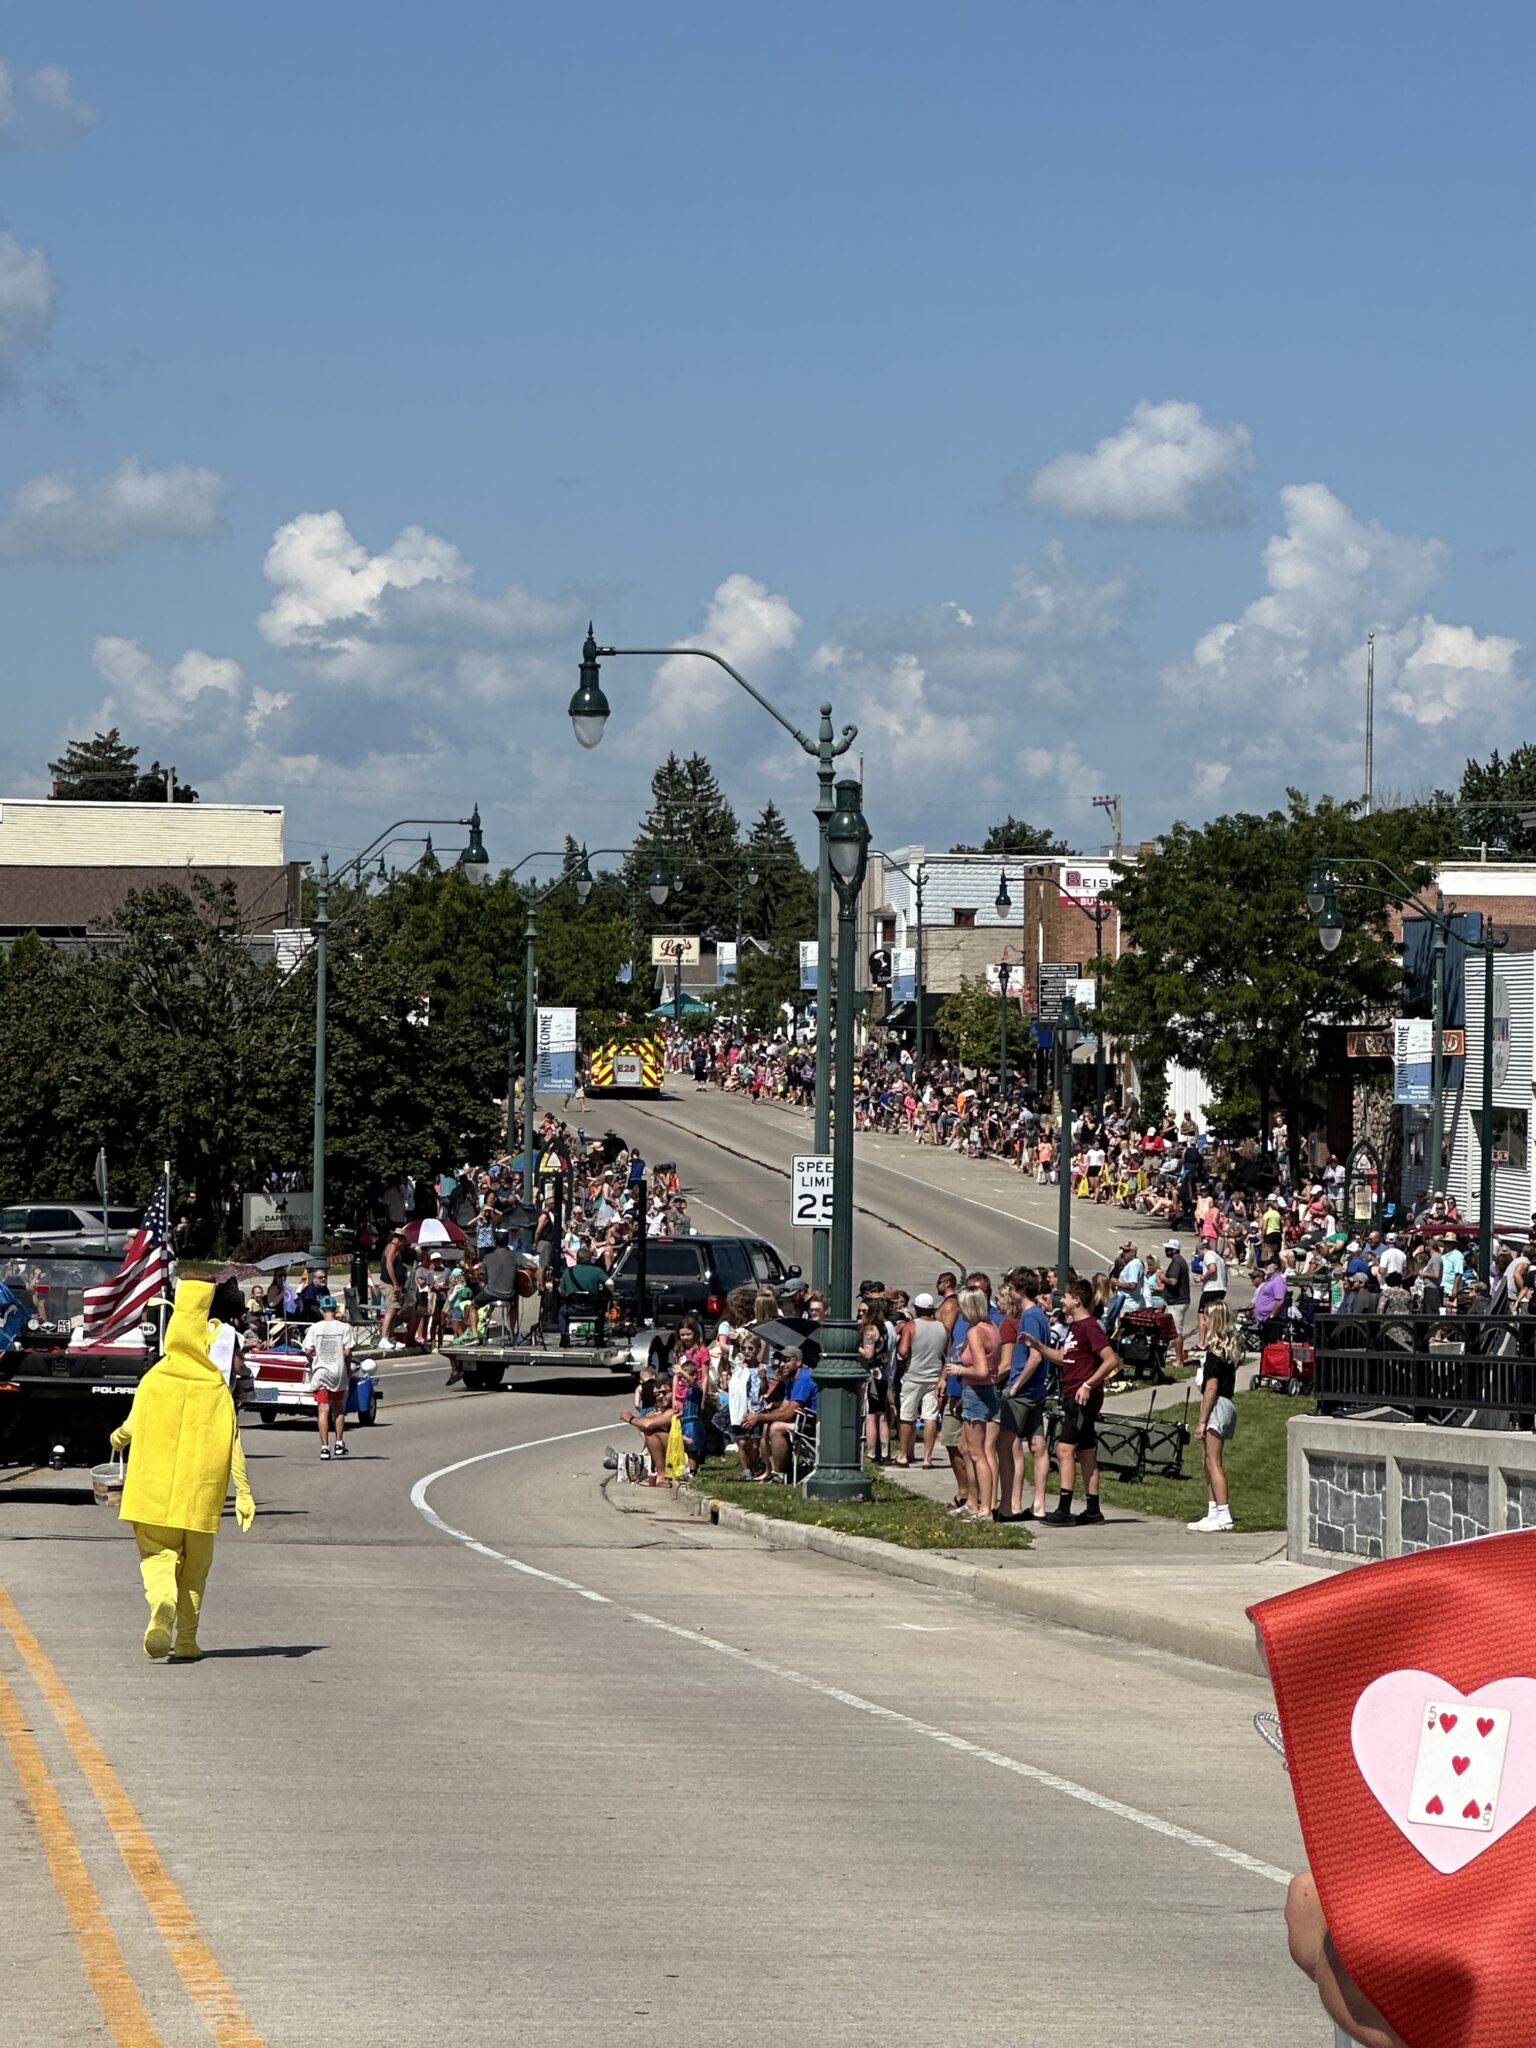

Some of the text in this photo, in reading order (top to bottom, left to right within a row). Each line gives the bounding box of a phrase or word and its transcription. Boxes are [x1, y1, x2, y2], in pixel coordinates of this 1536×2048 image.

[540, 1014, 553, 1077] WINNECONNE
[1397, 1026, 1410, 1089] WINNECONNE
[617, 1065, 636, 1073] E28
[797, 1161, 835, 1173] SPEE
[797, 1193, 834, 1219] 25
[1428, 1705, 1437, 1720] 5
[1482, 1812, 1491, 1826] 5
